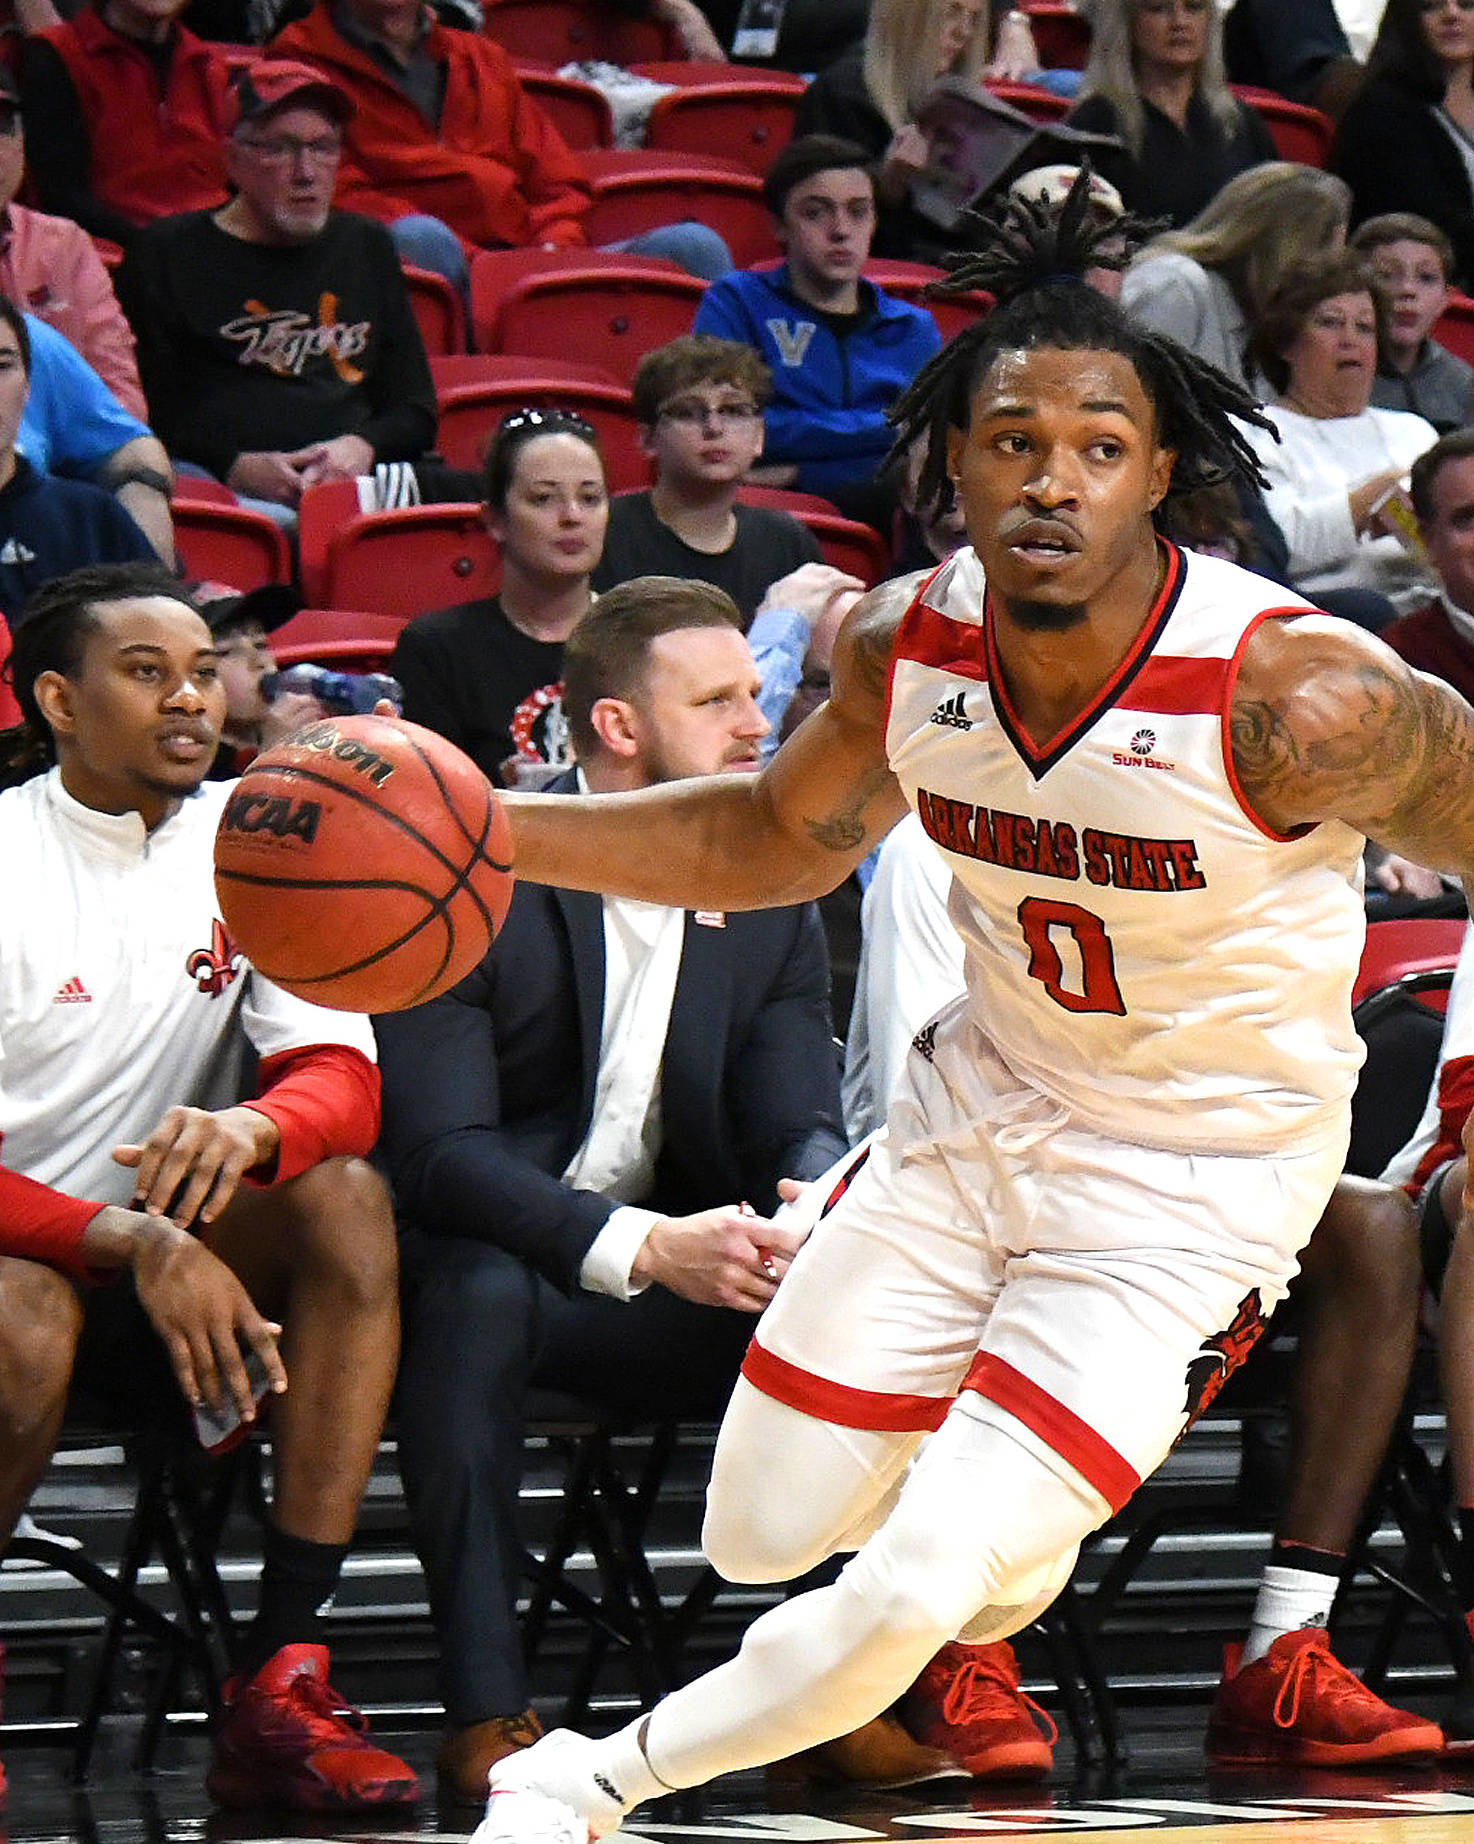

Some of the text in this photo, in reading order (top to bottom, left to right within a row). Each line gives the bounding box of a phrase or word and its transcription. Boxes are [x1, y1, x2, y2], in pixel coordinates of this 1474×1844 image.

[766, 318, 817, 367] V
[930, 711, 973, 731] adidas
[1112, 752, 1175, 770] SUN BELT
[917, 787, 1207, 892] ARKANSAS STATE
[1017, 896, 1128, 1017] 0
